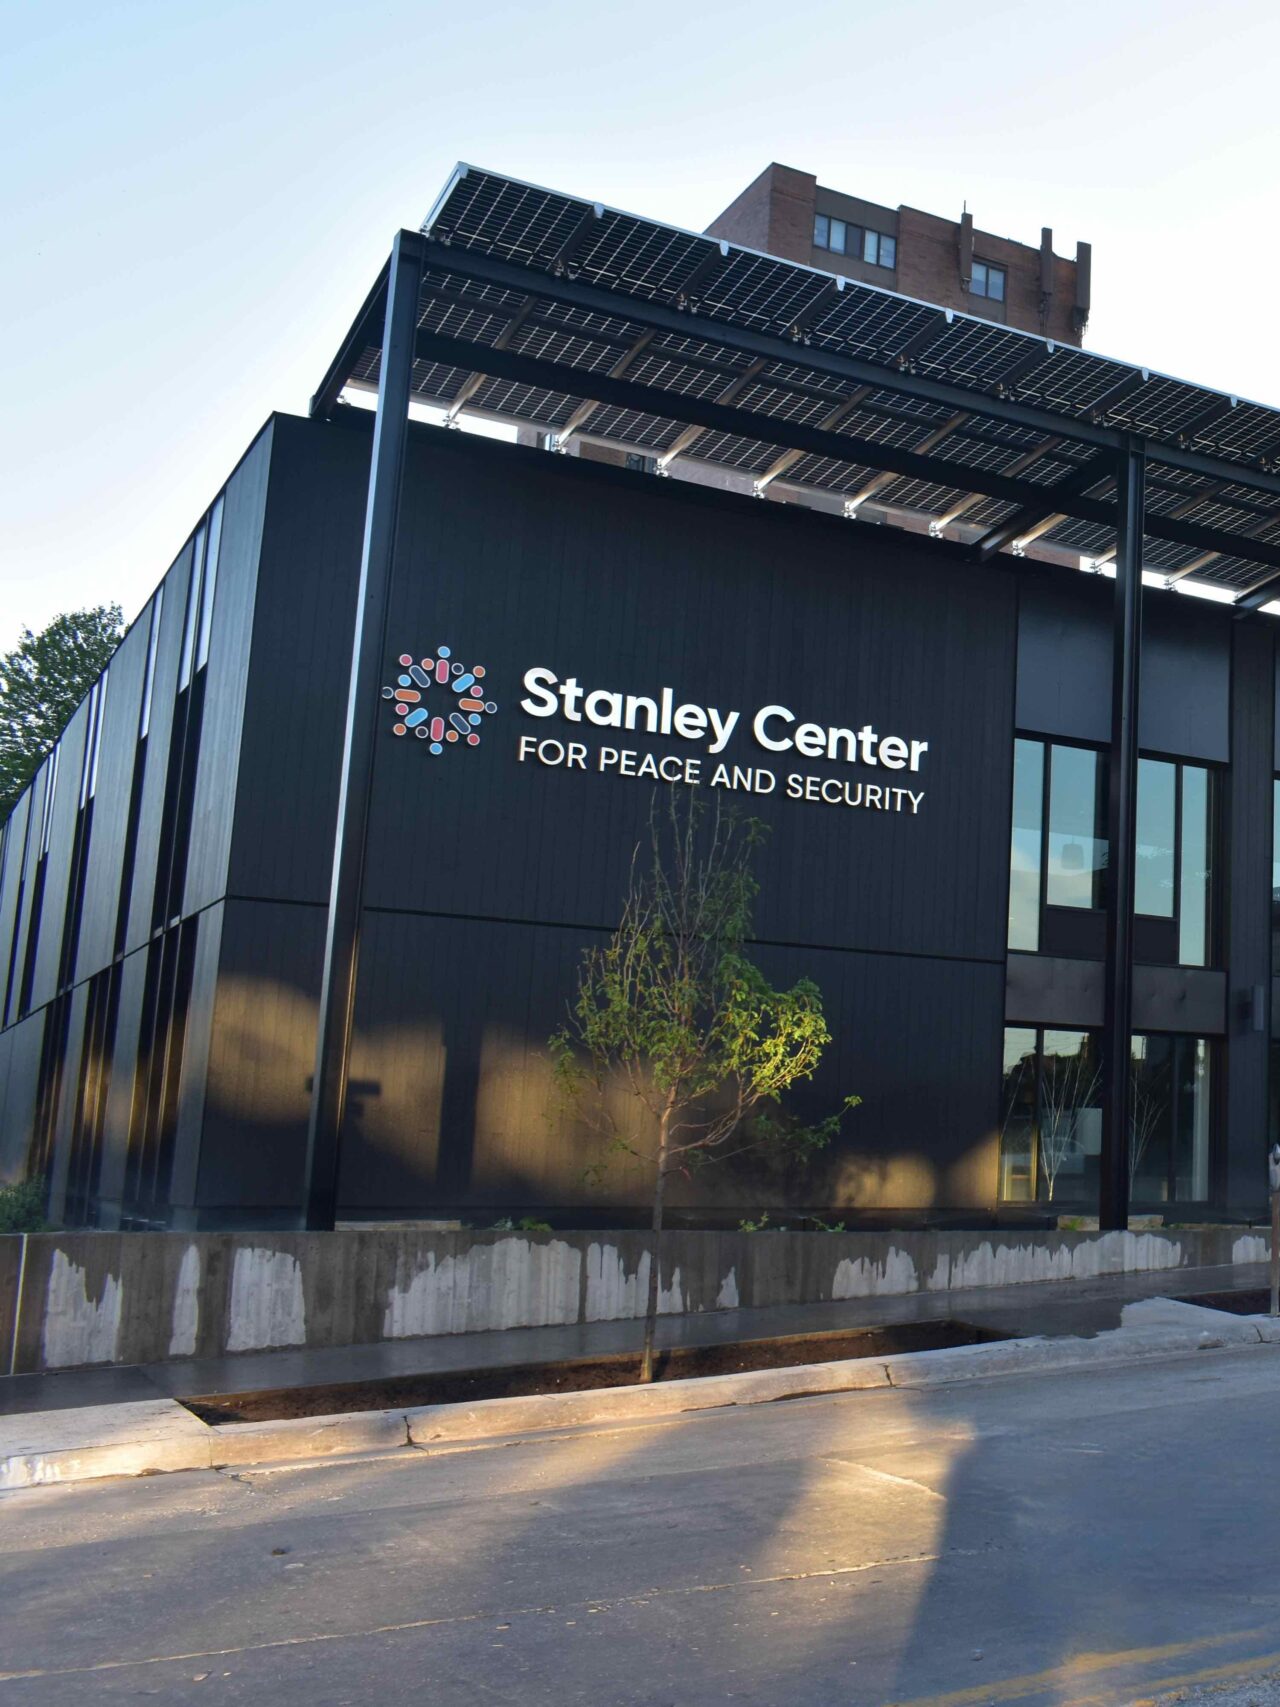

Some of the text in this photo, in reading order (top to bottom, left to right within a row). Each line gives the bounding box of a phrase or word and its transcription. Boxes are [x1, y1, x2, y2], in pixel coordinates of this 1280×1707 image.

[519, 666, 929, 772] Stanley Center
[518, 734, 926, 815] FOR PEACE AND SECURITY
